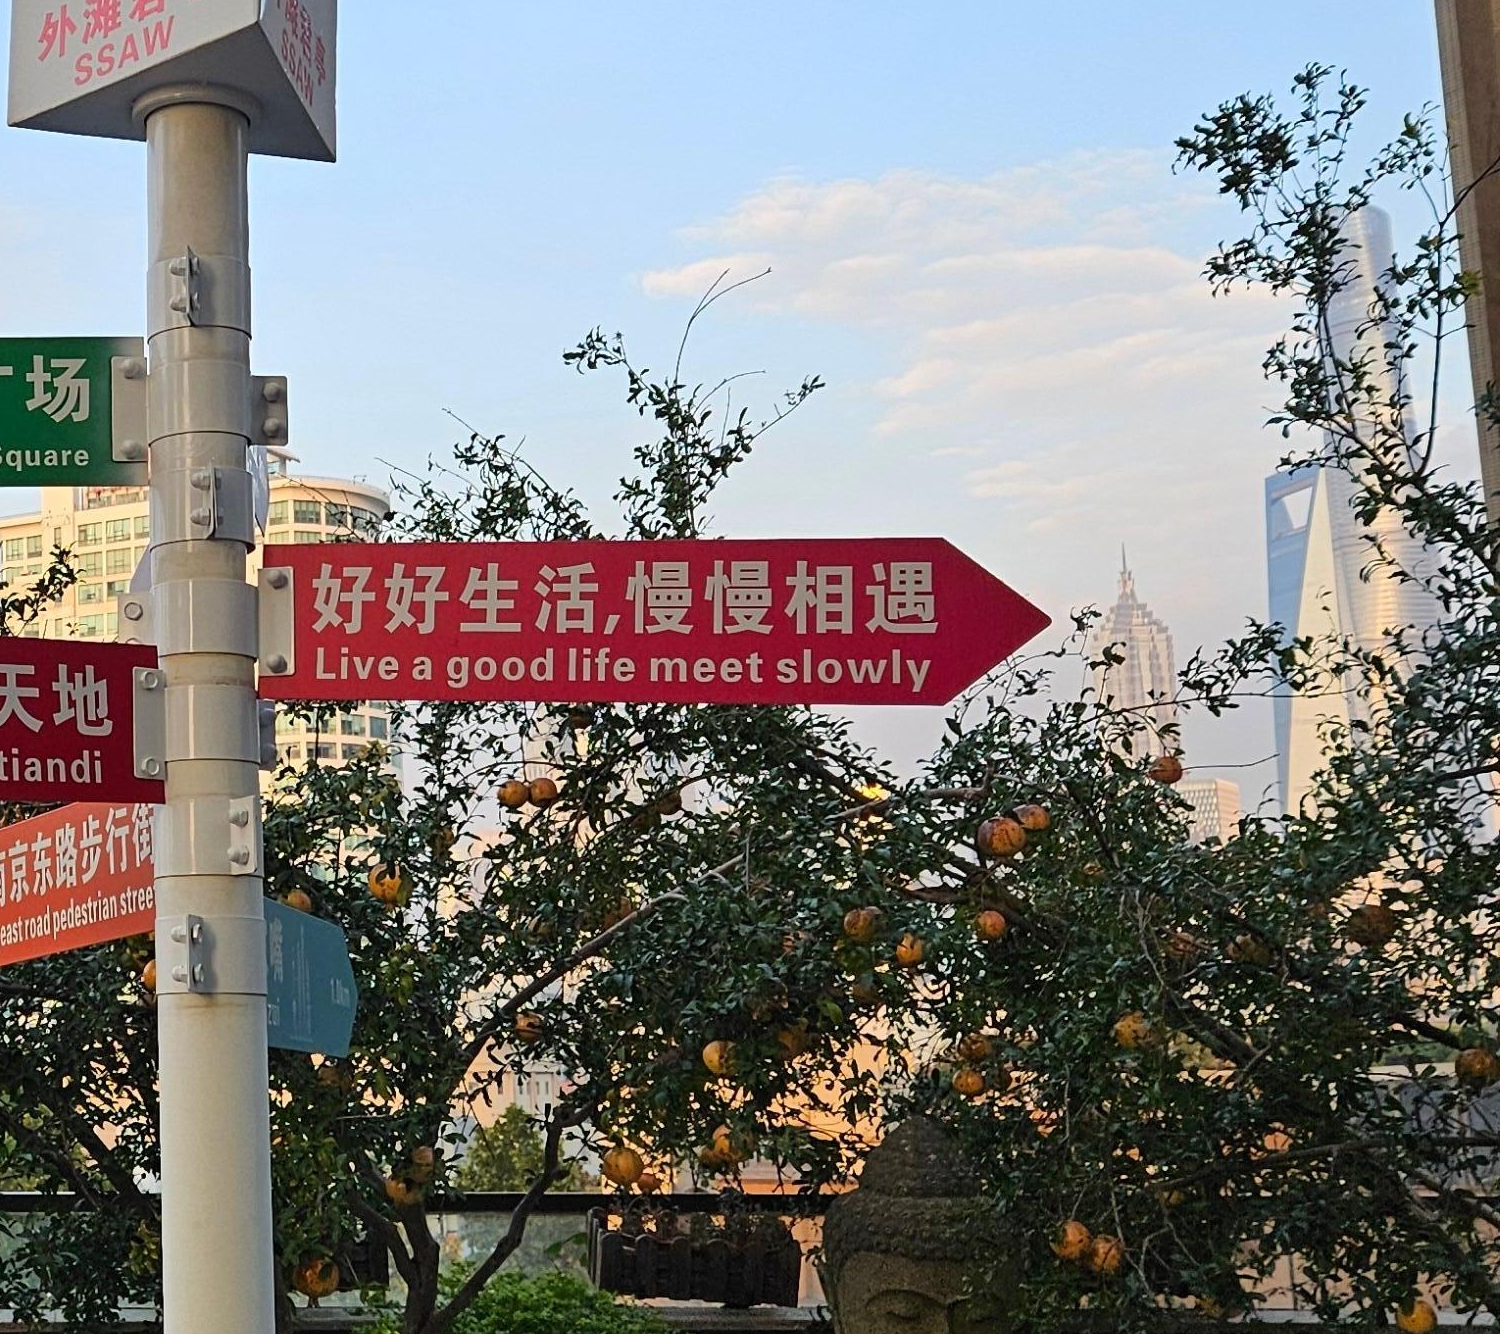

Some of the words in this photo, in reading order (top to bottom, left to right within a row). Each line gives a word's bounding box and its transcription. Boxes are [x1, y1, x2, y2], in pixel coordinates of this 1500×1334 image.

[73, 16, 175, 86] SSAW
[315, 647, 399, 680] Live
[412, 655, 433, 681] a
[446, 647, 556, 689] good
[568, 647, 636, 682] life
[649, 651, 762, 683] meet
[776, 648, 931, 693] slowly
[0, 919, 24, 946] east
[25, 905, 51, 941] road
[52, 890, 118, 940] pedestrian
[119, 885, 155, 916] stree
